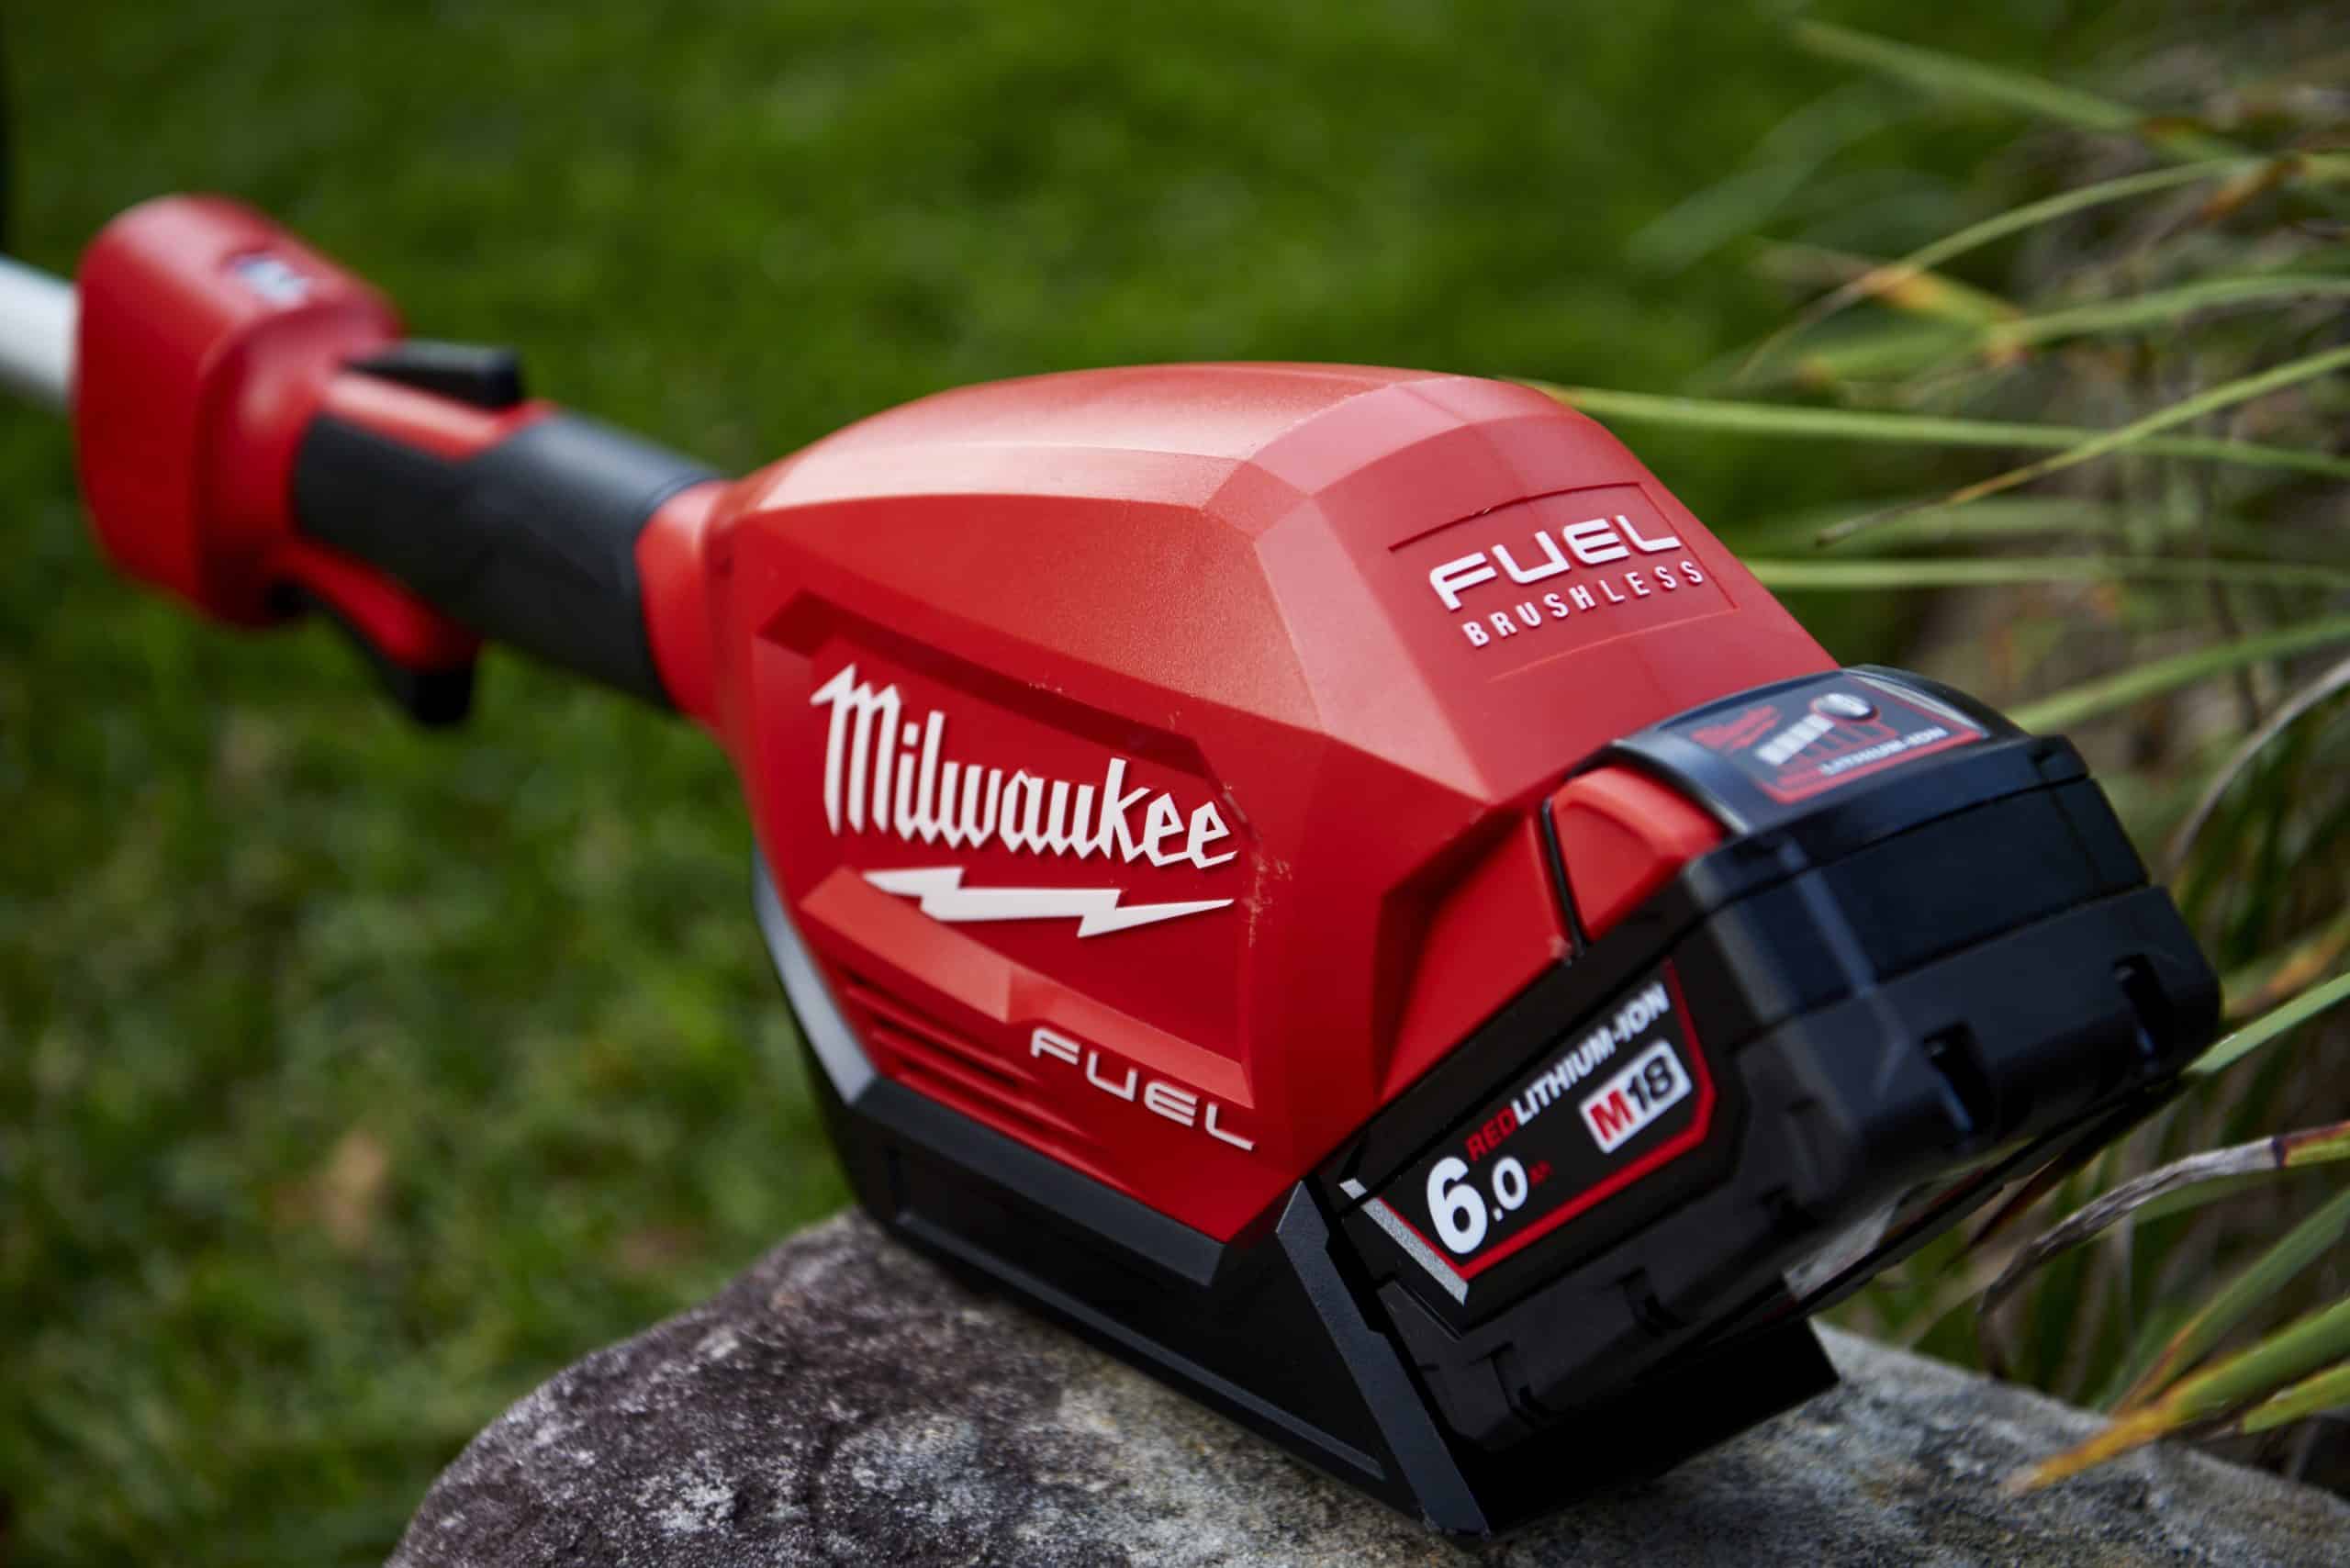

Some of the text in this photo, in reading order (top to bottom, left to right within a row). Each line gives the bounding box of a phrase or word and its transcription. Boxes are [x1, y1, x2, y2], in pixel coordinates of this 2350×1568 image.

[1429, 515, 1682, 610] FUEL
[1462, 560, 1703, 646] BRUSHLESS
[810, 663, 1238, 869] Milwaukee
[1030, 1027, 1255, 1151] FUEL
[1589, 1055, 1674, 1143] M18
